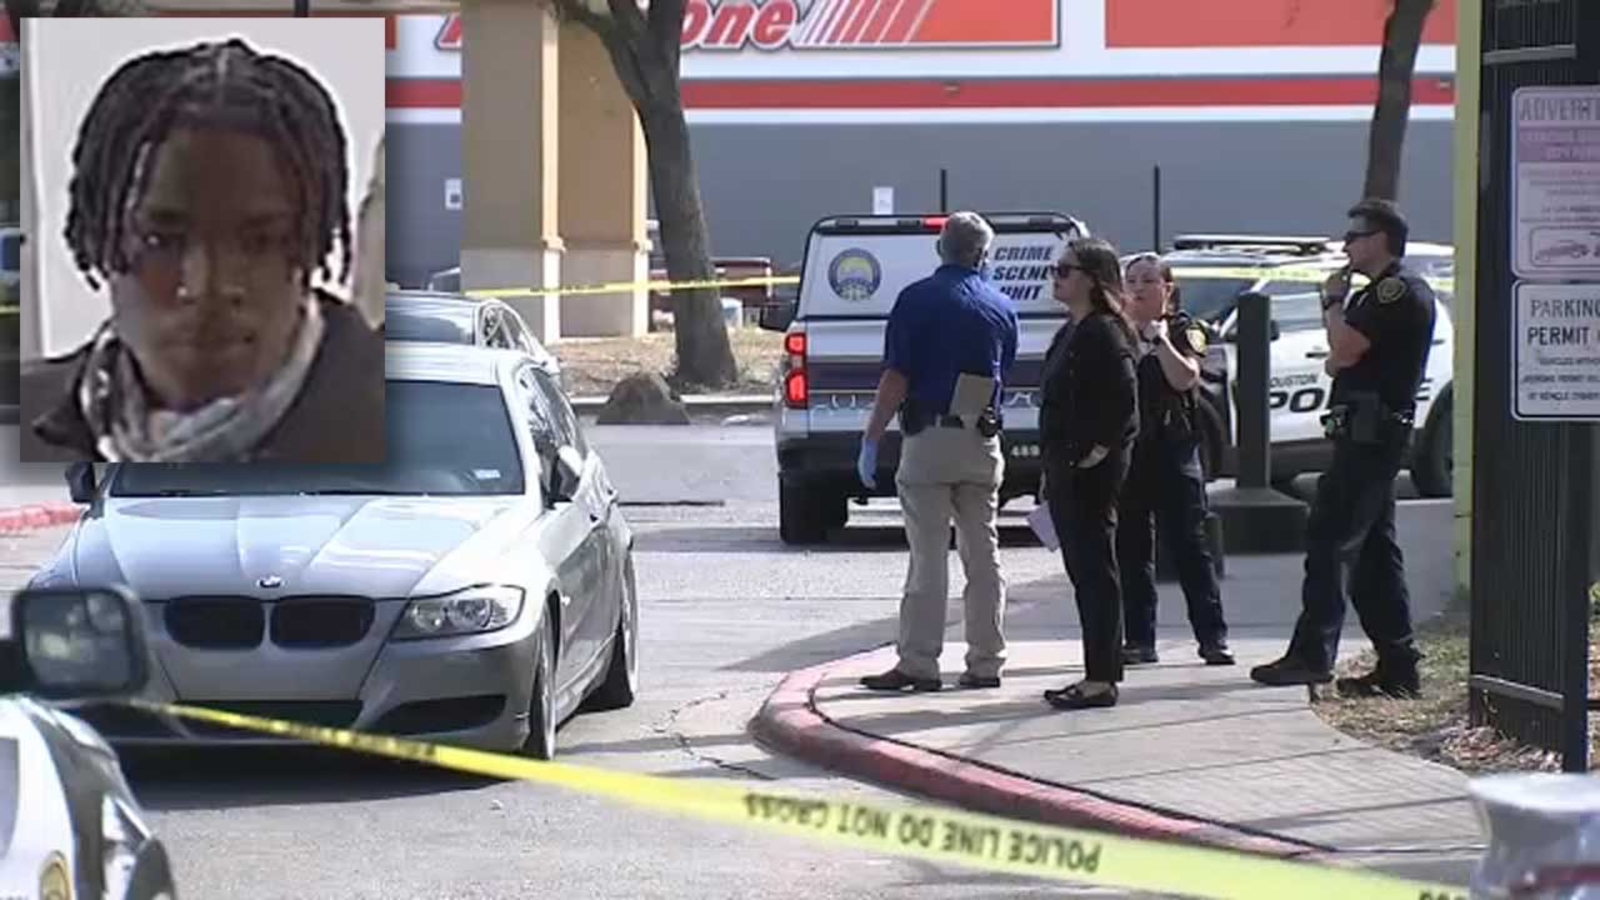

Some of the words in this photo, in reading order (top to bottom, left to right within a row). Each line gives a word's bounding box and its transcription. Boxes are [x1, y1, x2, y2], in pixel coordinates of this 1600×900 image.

[994, 247, 1054, 261] CRIME
[1527, 326, 1590, 346] PERMIT
[1270, 373, 1318, 388] OUSTON
[837, 803, 890, 838] NOT
[899, 814, 934, 848] DO
[942, 820, 1000, 858] LINE
[1008, 831, 1103, 873] POLICE
